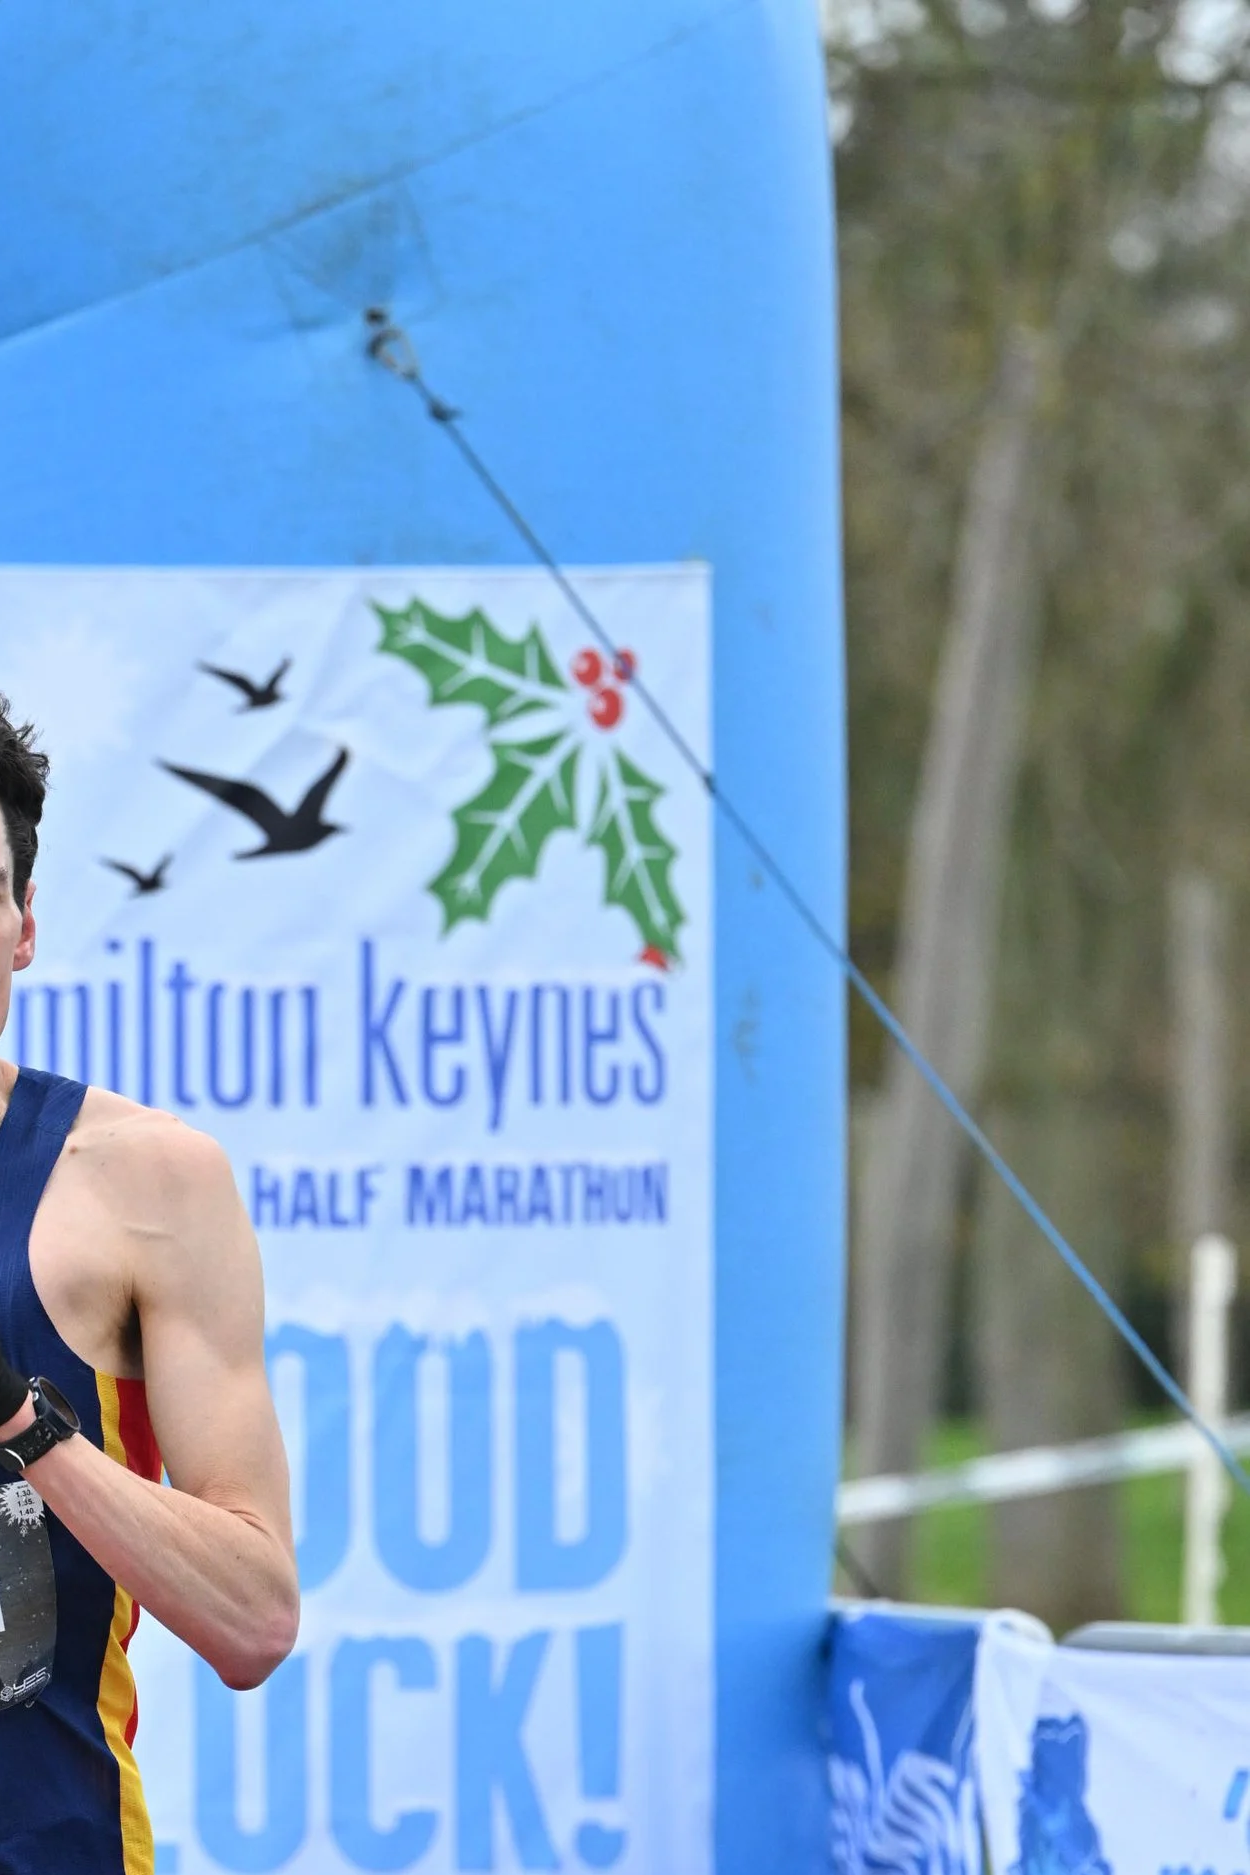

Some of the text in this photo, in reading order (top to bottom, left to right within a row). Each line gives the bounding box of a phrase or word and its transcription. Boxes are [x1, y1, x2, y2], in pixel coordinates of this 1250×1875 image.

[359, 938, 669, 1132] keynes
[251, 1162, 669, 1227] HALF MARATHON
[262, 1314, 630, 1596] OOD
